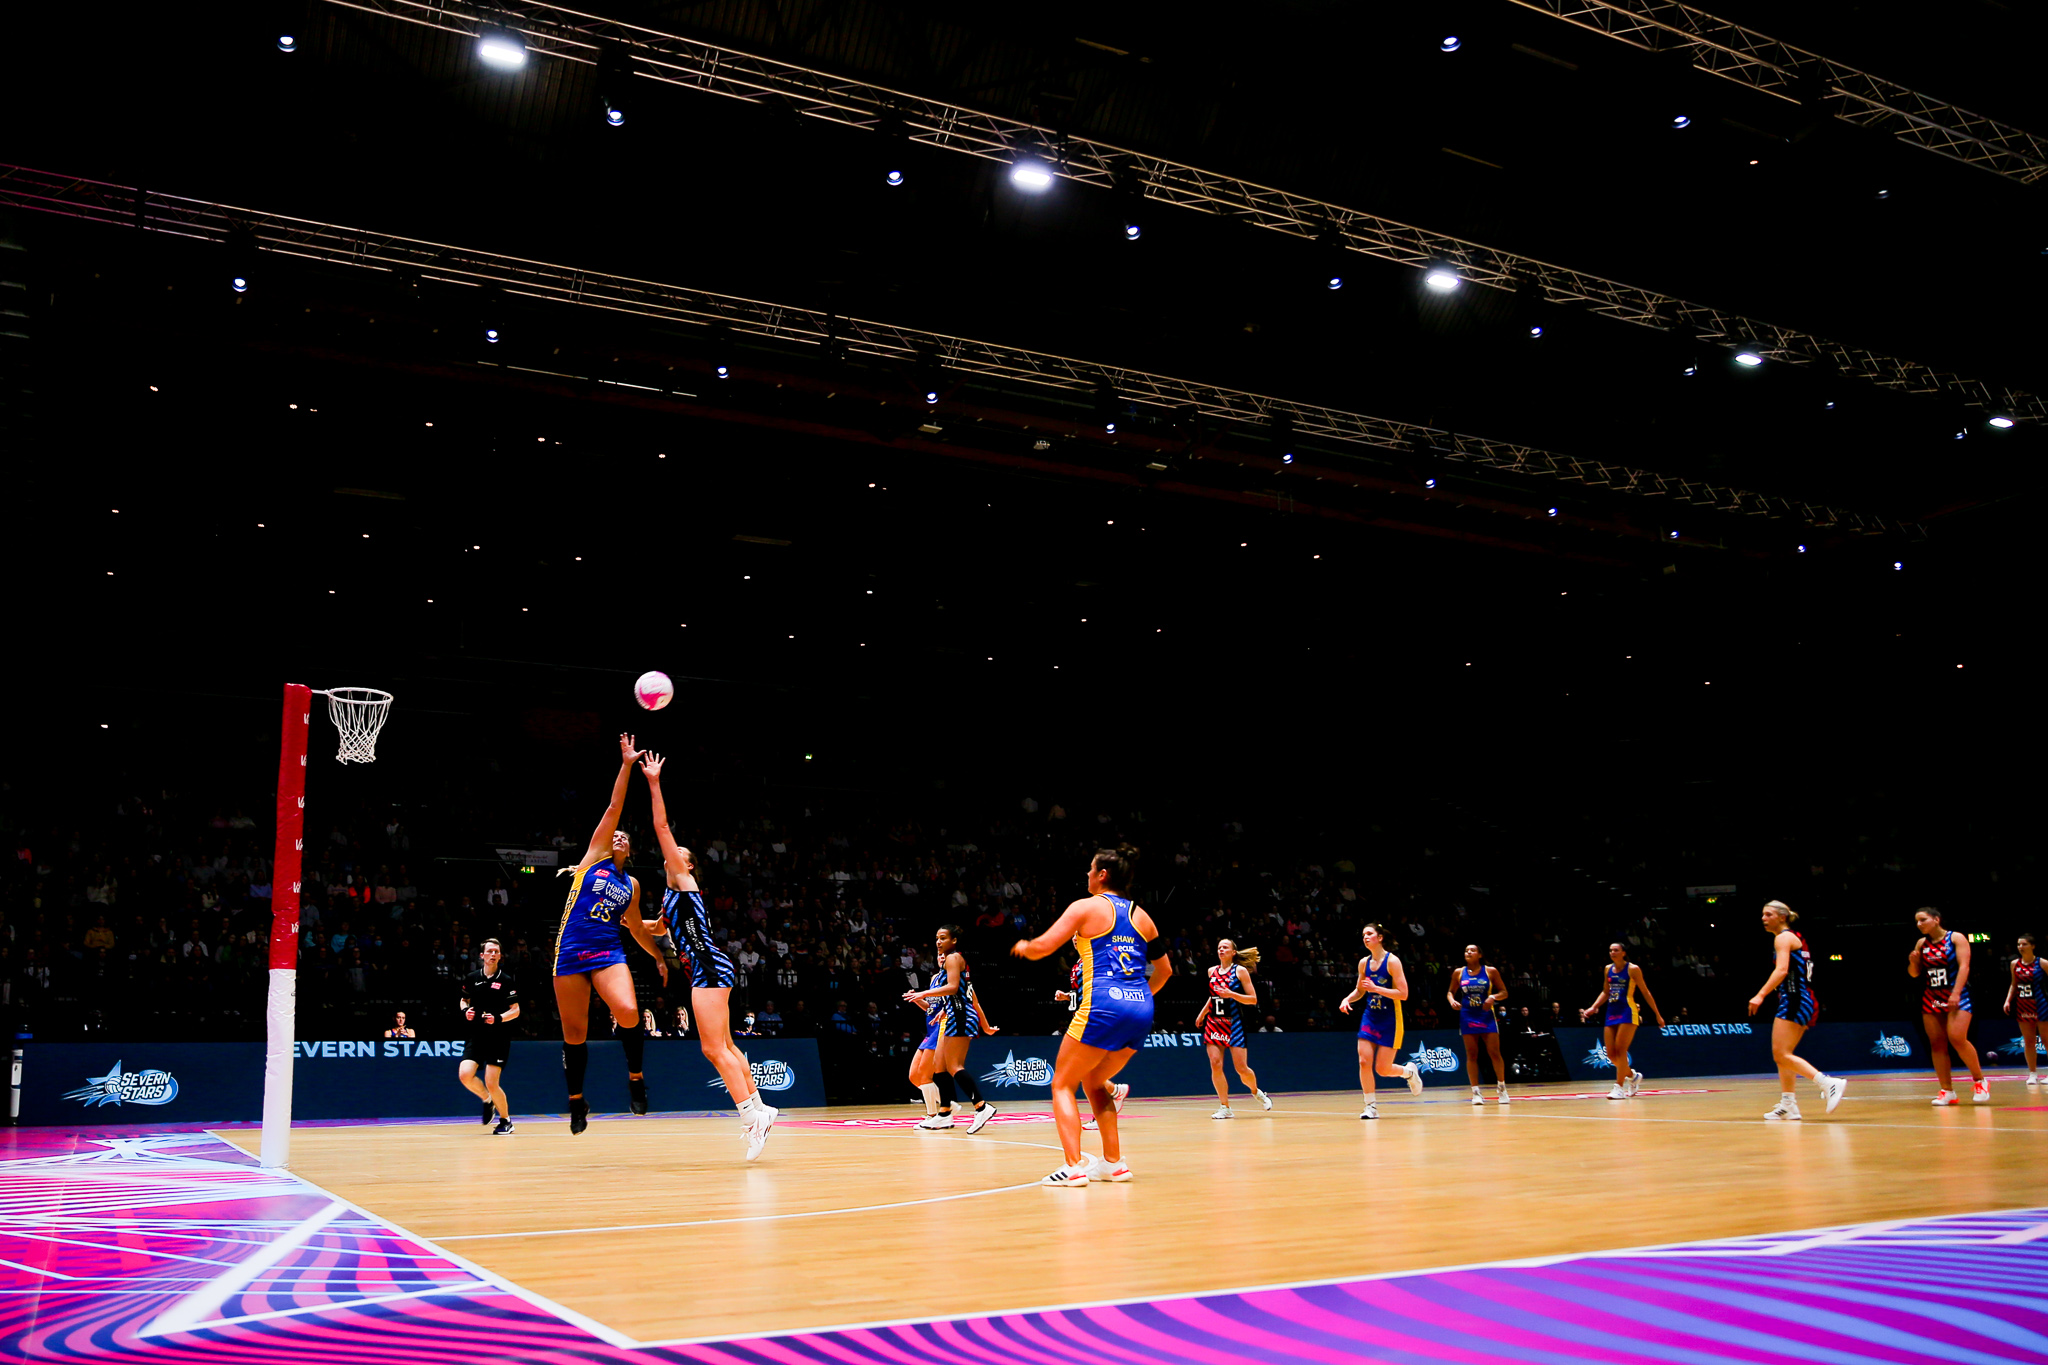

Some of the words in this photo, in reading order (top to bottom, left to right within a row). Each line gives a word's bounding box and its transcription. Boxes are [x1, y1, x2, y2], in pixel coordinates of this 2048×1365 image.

[605, 888, 625, 906] Watts
[590, 902, 614, 922] GS
[1112, 935, 1135, 944] SHAW
[1119, 952, 1135, 976] C
[1123, 991, 1145, 1000] BATH
[1215, 998, 1225, 1016] C
[1660, 1024, 1711, 1036] SEVERN
[1712, 1023, 1752, 1035] STARS
[293, 1041, 376, 1058] EVERN
[383, 1041, 466, 1057] STARS
[1426, 1048, 1452, 1059] SEVERN
[750, 1061, 787, 1075] SEVERN
[1015, 1059, 1047, 1071] SEVERN
[1430, 1057, 1451, 1069] STARS
[120, 1071, 171, 1087] SEVERN
[753, 1073, 784, 1087] STARS
[1017, 1069, 1045, 1082] STARS
[120, 1085, 165, 1100] STARS
